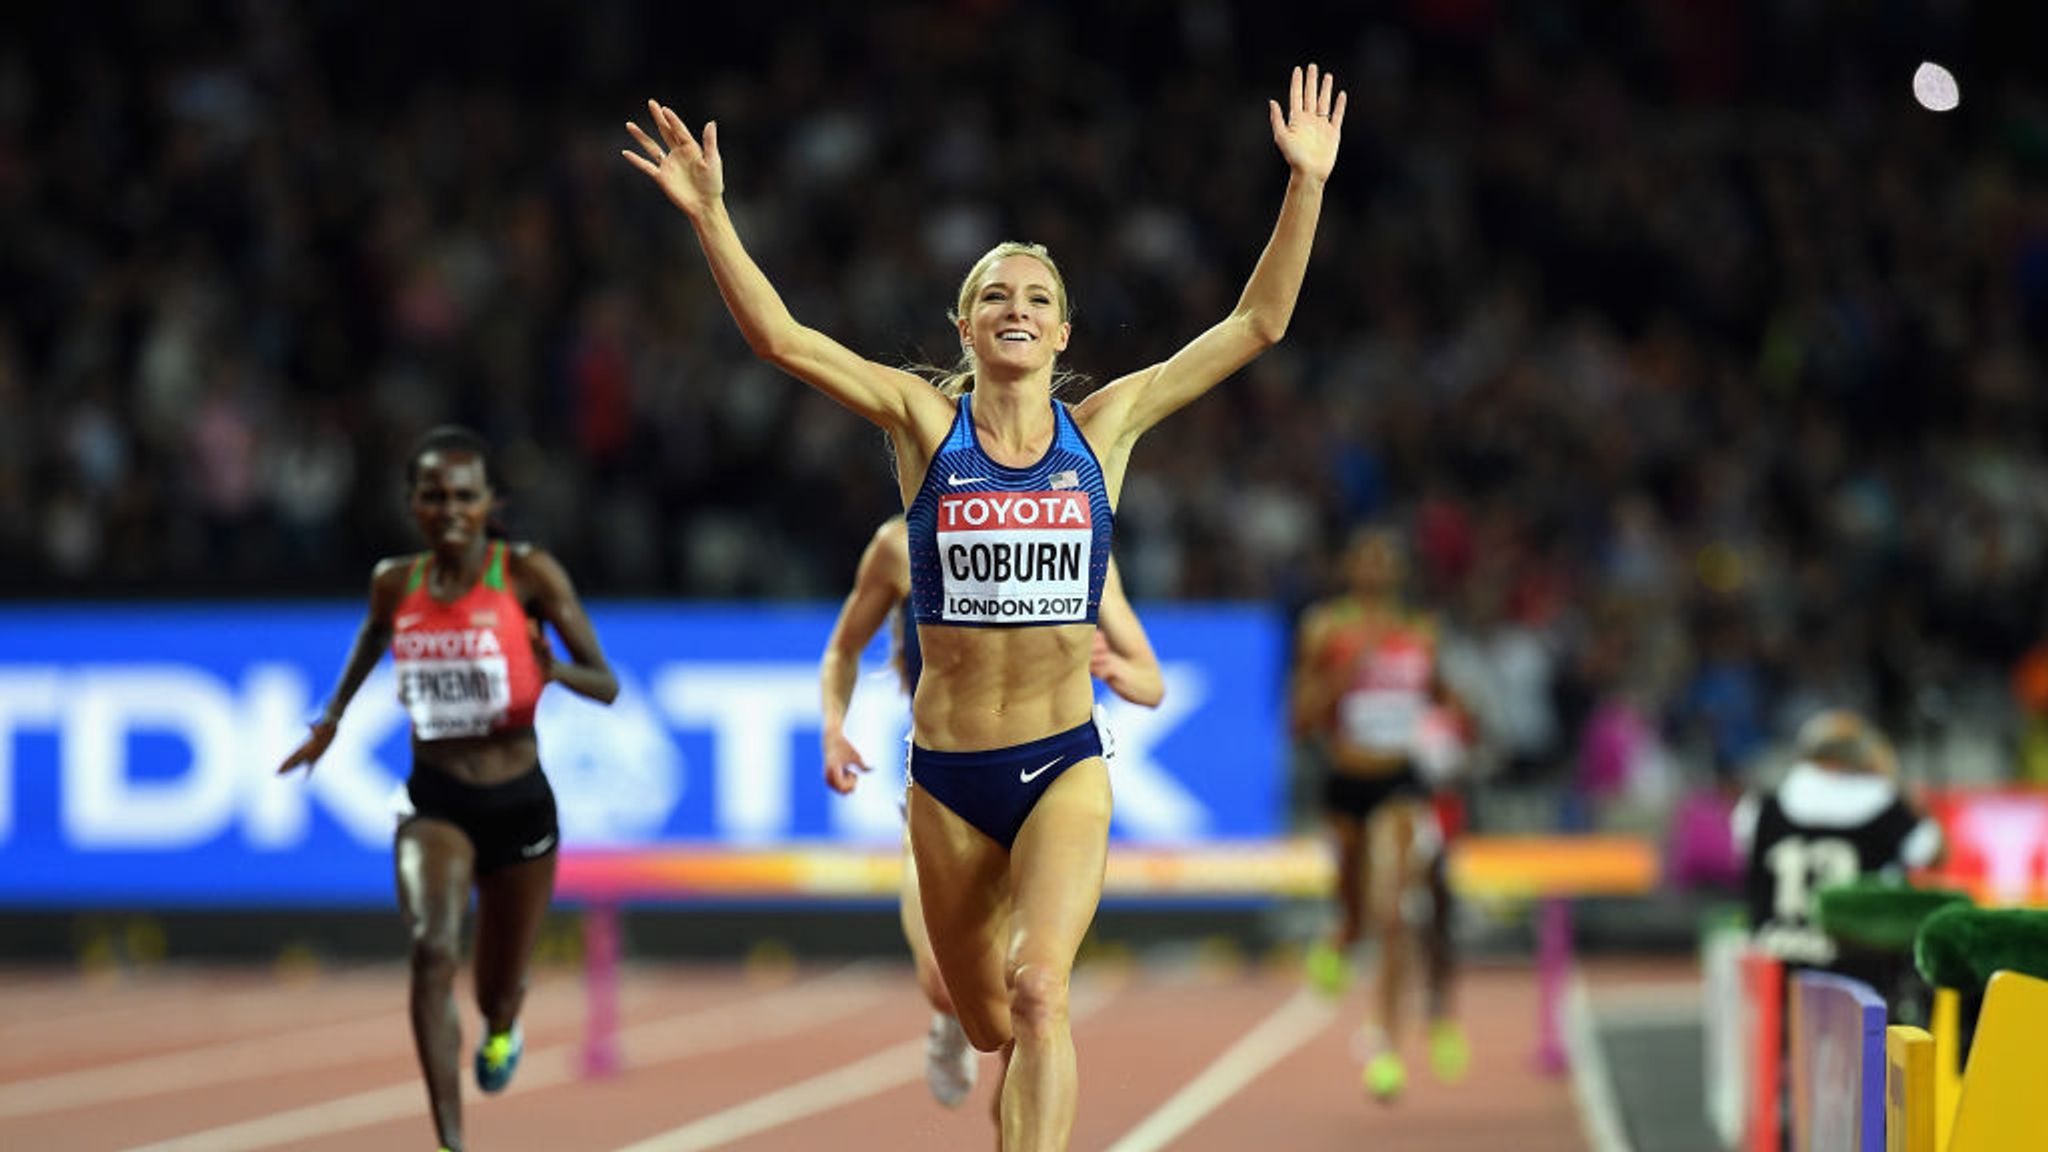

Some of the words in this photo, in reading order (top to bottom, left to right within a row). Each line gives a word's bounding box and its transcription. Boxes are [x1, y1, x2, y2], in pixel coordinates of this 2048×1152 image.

[943, 497, 1085, 526] TOYOTA
[949, 542, 1081, 582] COBURN
[949, 598, 1034, 616] LONDON
[1038, 598, 1083, 615] 2017
[395, 629, 501, 659] TOYOTA
